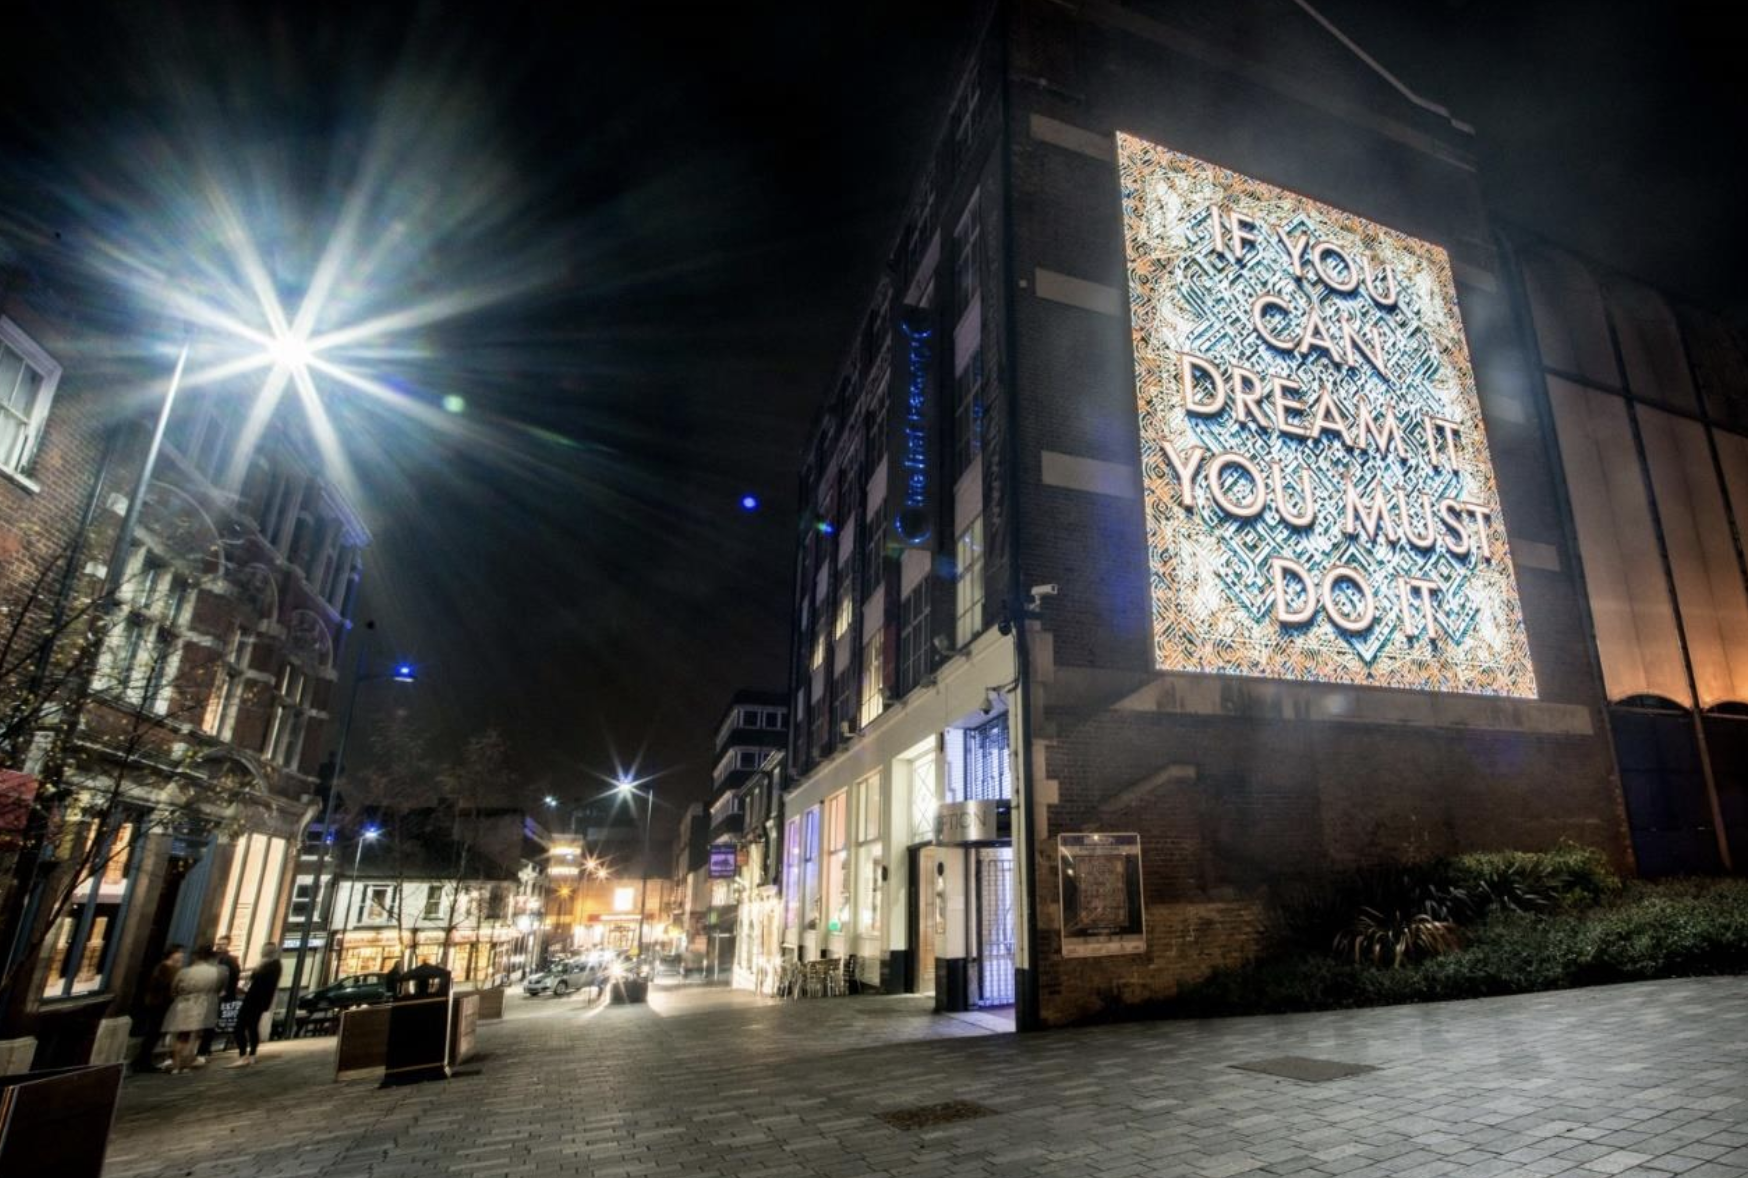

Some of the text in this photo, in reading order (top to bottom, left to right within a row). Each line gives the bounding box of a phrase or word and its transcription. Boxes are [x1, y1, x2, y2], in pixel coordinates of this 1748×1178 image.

[1209, 204, 1396, 306] IF YOU
[1252, 294, 1389, 378] CAN
[1180, 353, 1460, 471] DREAM IT
[1162, 440, 1491, 558] YOU MUST
[1271, 557, 1439, 640] DO IT
